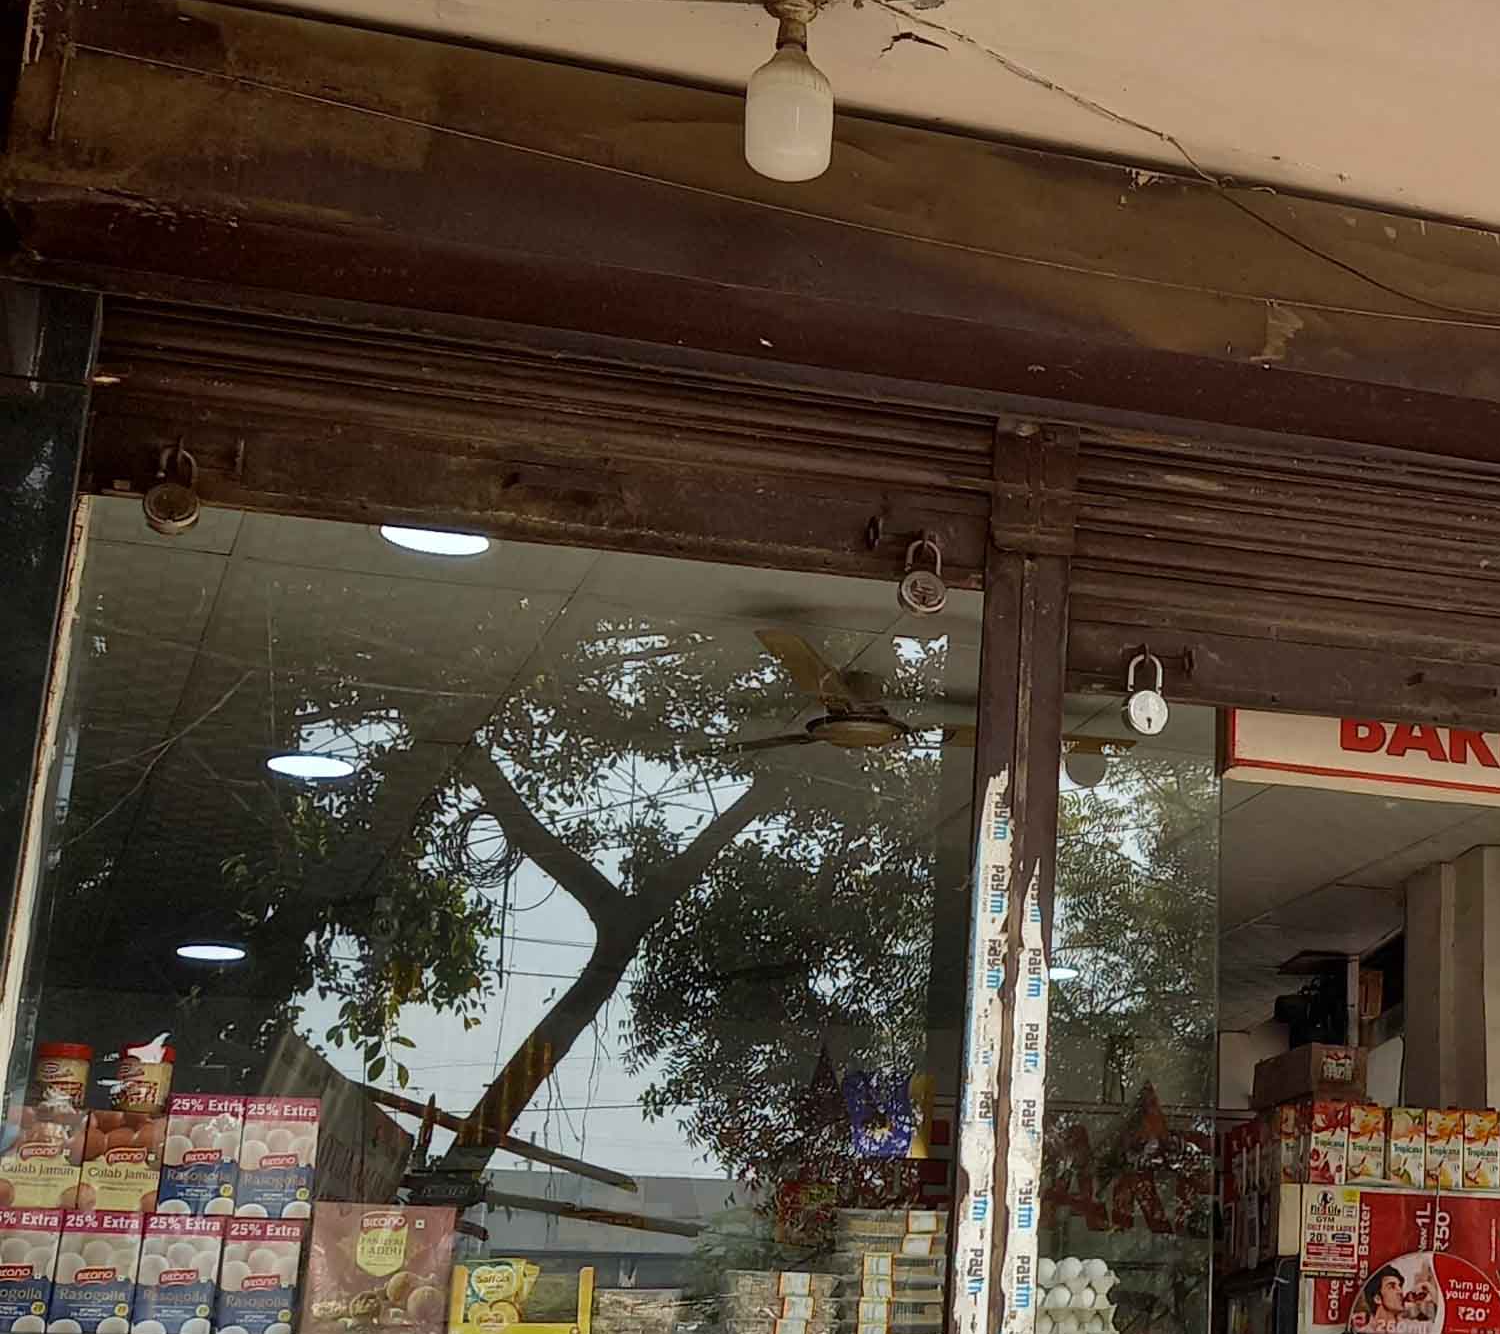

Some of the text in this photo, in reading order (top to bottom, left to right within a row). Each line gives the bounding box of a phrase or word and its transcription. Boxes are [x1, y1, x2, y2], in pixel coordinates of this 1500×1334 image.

[988, 864, 1006, 915] Paytm
[1026, 948, 1042, 999] Paytm
[172, 1098, 244, 1115] 25% Extra
[248, 1104, 318, 1118] 25% Extra
[87, 1168, 122, 1179] Gulab
[22, 1212, 58, 1227] Extra
[66, 1214, 140, 1230] 25% Extra
[150, 1216, 221, 1232] 25% Extra
[230, 1222, 301, 1238] 25% Extra
[1359, 1203, 1371, 1256] Better
[1014, 1254, 1031, 1309] Paytm
[1448, 1278, 1490, 1295] Turn up
[1327, 1279, 1341, 1321] Coke
[1445, 1289, 1493, 1304] your day
